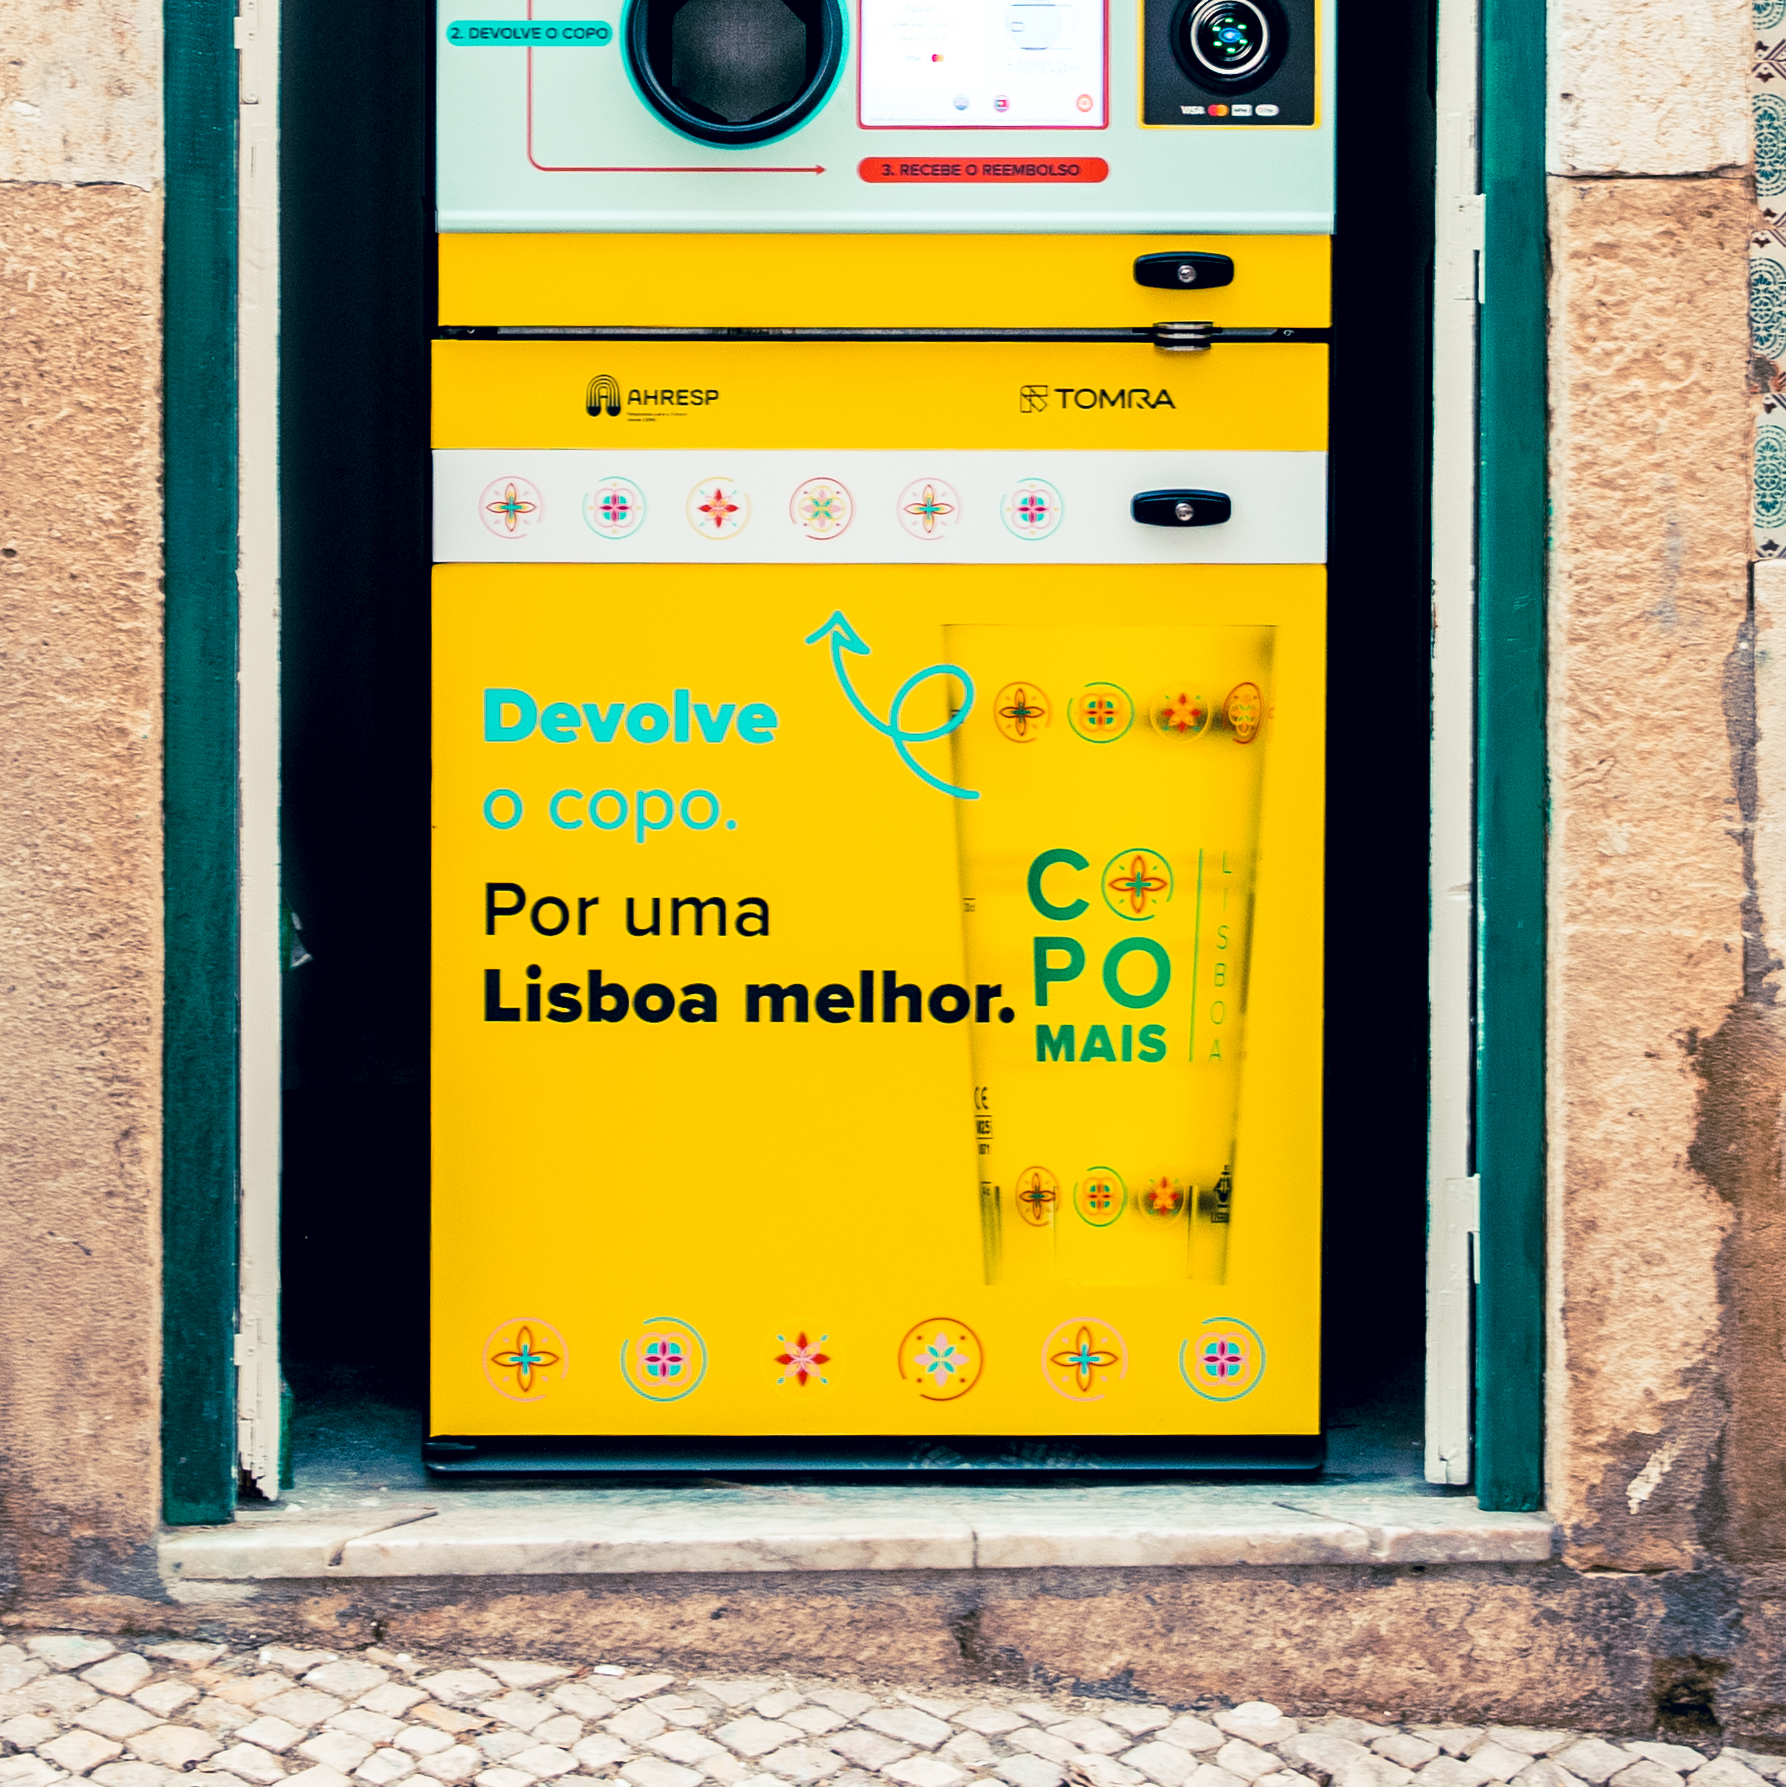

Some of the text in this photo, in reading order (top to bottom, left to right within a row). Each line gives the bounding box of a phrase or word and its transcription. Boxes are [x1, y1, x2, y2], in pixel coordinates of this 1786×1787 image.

[451, 27, 609, 41] 2. DEVOLVE O COPO
[881, 163, 1081, 177] 3. RECEBE O REEMBOLSO
[627, 389, 720, 406] AHRESP
[1053, 387, 1176, 410] TOMRA
[483, 687, 778, 745] Devolve
[483, 788, 737, 844] o copo.
[484, 881, 772, 938] Por uma
[483, 964, 1017, 1025] Lisboa melhor.
[1035, 1023, 1168, 1064] MAIS
